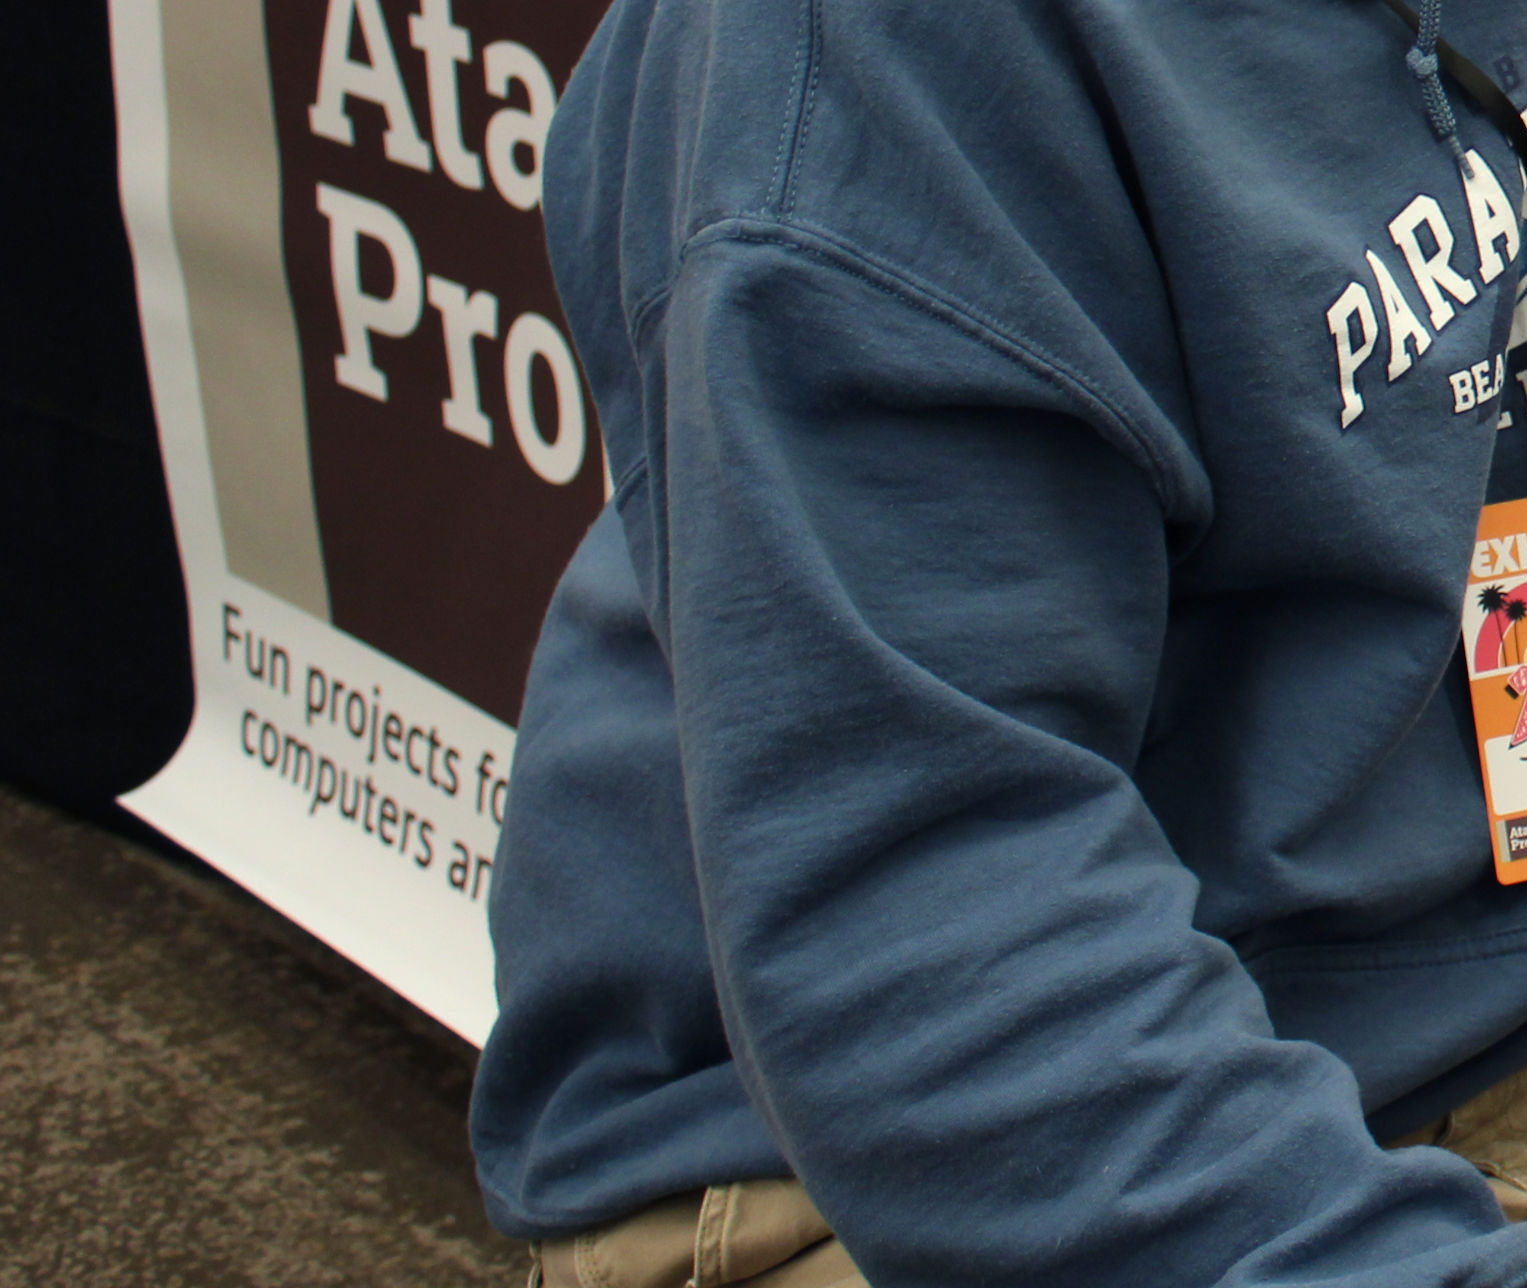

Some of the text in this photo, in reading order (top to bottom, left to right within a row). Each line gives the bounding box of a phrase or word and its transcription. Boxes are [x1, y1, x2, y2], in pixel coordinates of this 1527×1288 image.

[221, 600, 291, 697] Fun
[305, 664, 462, 799] projects
[240, 708, 436, 870] computers
